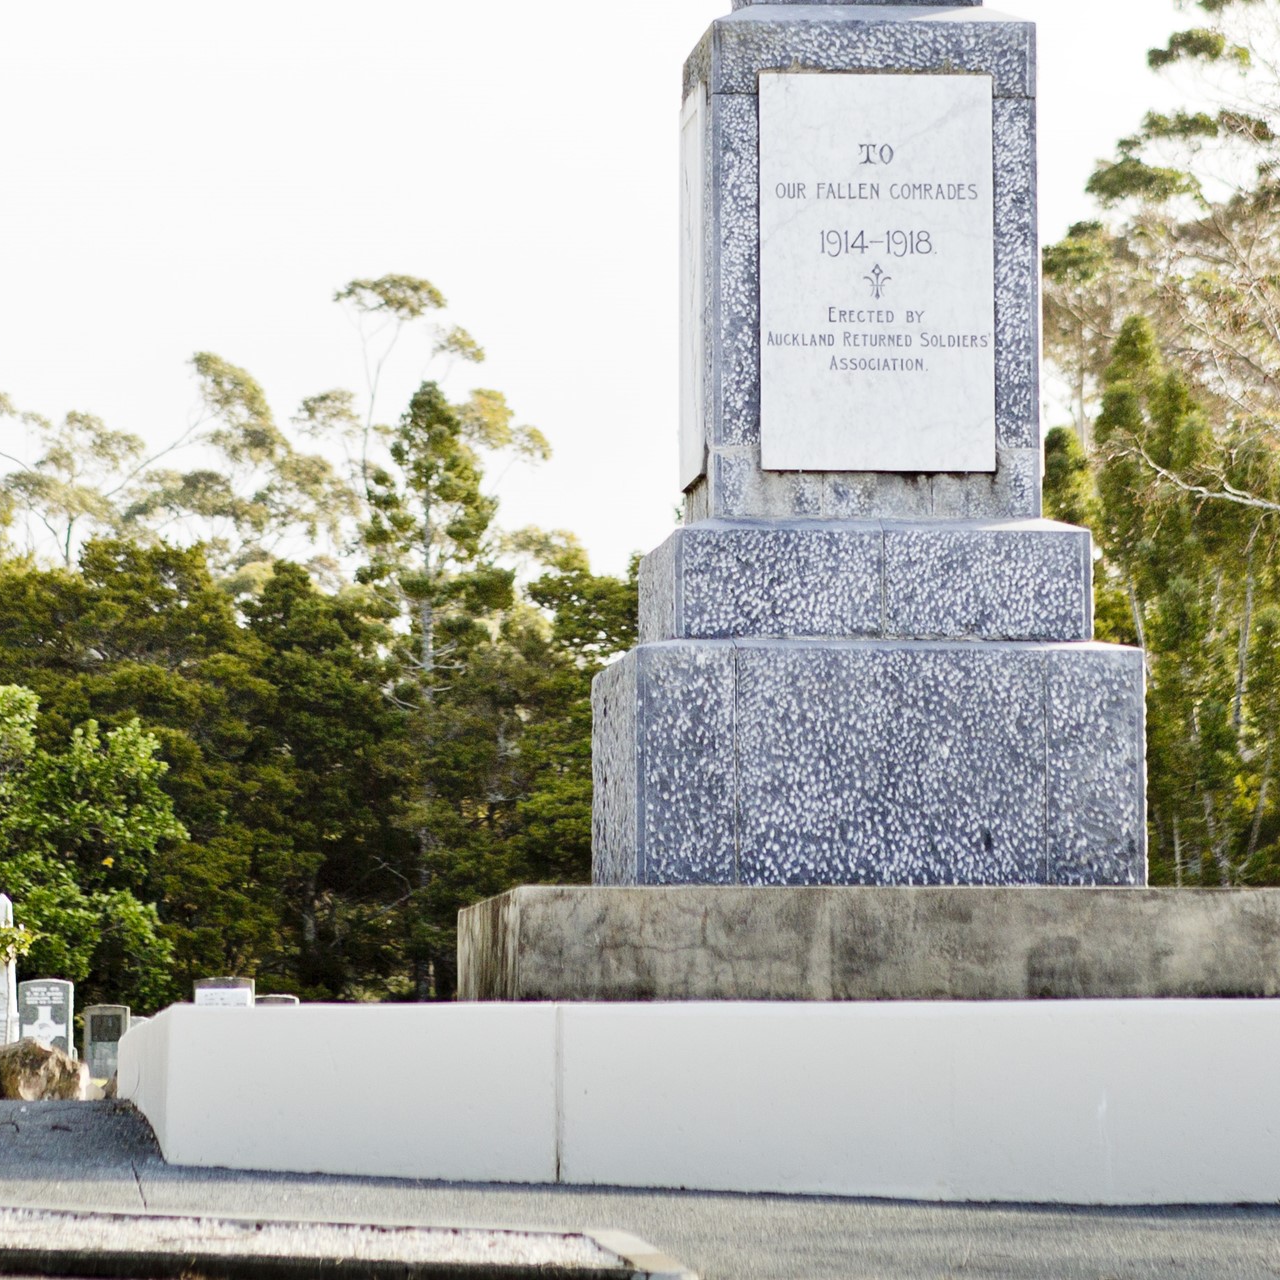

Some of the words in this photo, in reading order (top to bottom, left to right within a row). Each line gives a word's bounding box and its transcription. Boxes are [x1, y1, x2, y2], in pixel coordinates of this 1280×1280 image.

[858, 143, 894, 165] TO
[775, 182, 807, 200] OUR
[816, 182, 880, 200] FALLEN
[889, 183, 978, 200] COMRADES
[906, 310, 925, 323] BY
